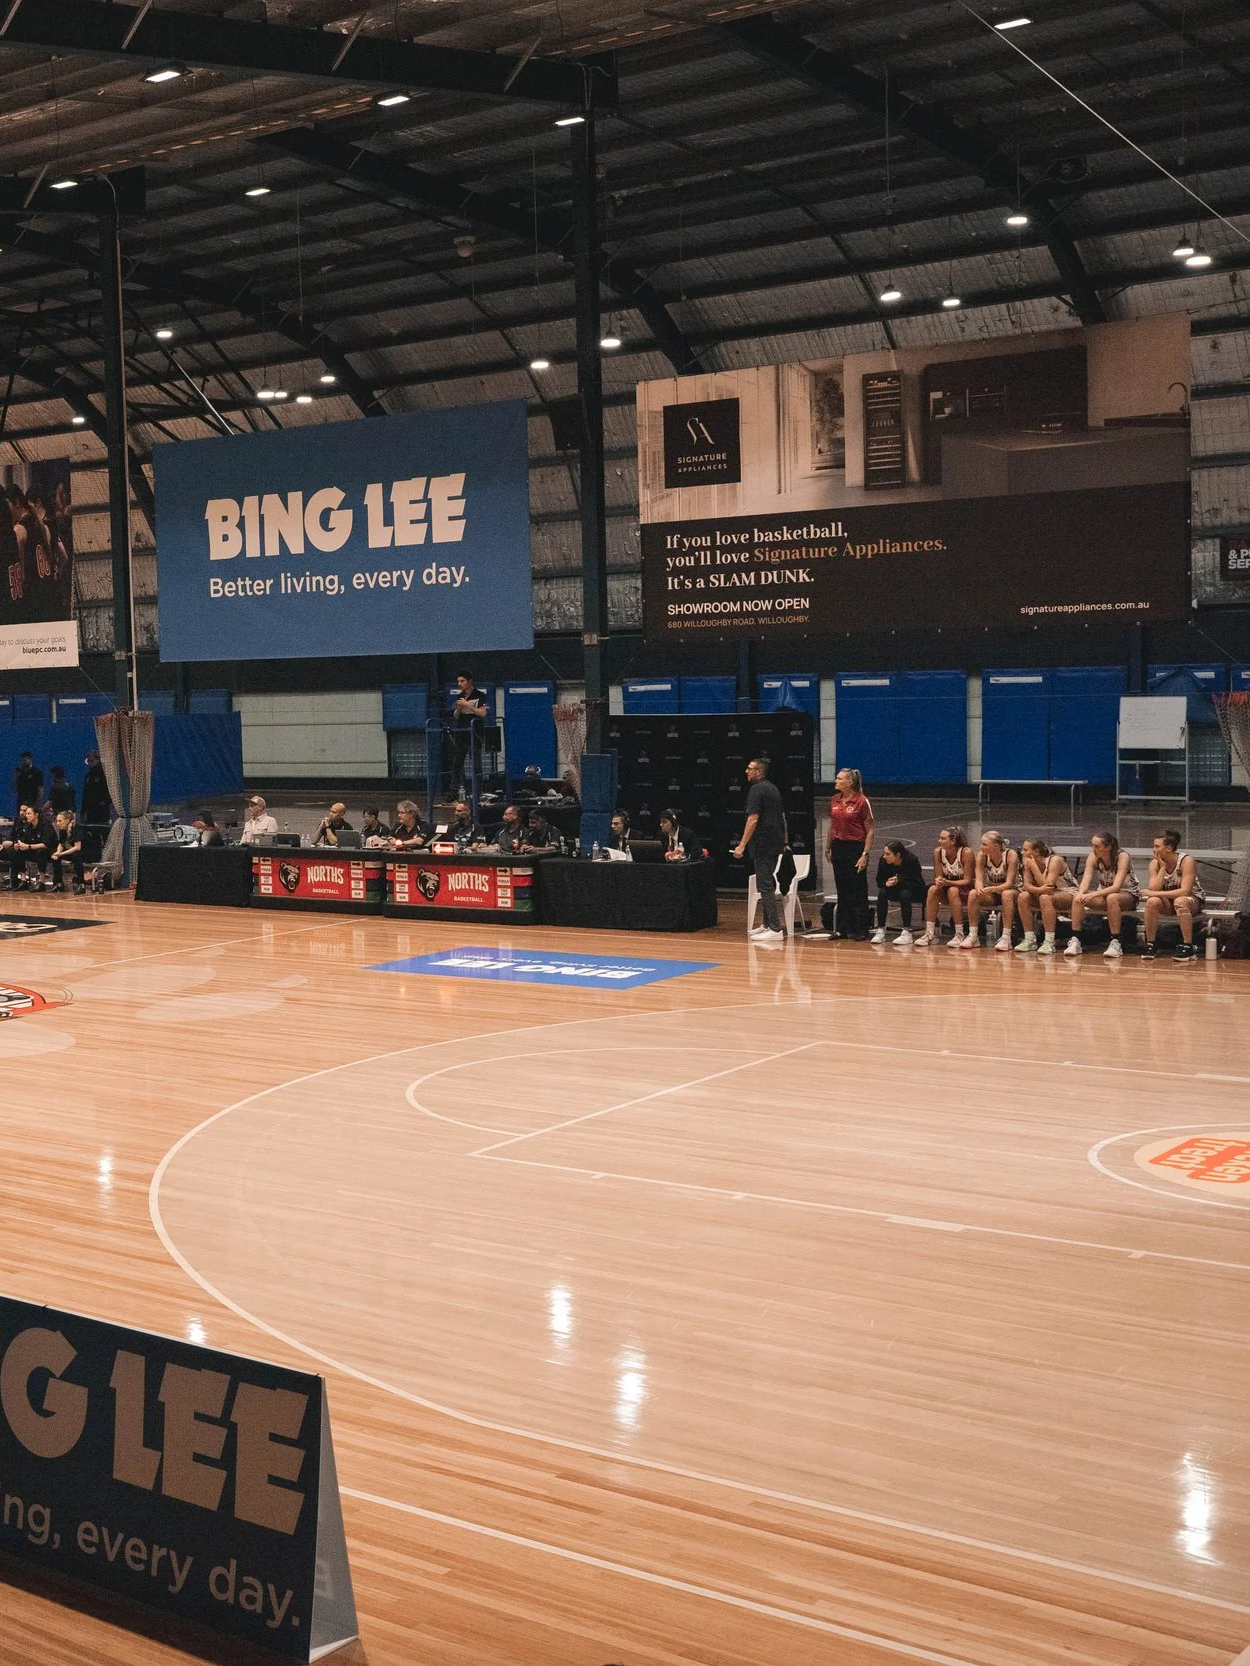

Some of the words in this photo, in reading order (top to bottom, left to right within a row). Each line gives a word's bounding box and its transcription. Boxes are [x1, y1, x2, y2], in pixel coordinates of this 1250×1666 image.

[677, 453, 727, 464] SIGNATURE
[677, 463, 727, 473] APPLIANCES
[204, 486, 353, 560] BING
[364, 472, 466, 549] LEE
[665, 534, 681, 549] If
[682, 536, 711, 552] you
[715, 531, 750, 546] love
[753, 521, 848, 543] basketball,
[665, 550, 712, 572] you’ll
[715, 550, 750, 565] love
[753, 546, 838, 565] Signature
[842, 539, 948, 559] Appliances.
[1228, 549, 1238, 559] &
[1240, 549, 1250, 559] P
[209, 576, 274, 598] Better
[280, 570, 345, 596] living,
[352, 567, 415, 592] every
[422, 561, 470, 589] day.
[666, 574, 692, 590] It’s
[695, 578, 705, 589] a
[709, 571, 756, 588] SLAM
[759, 568, 815, 585] DUNK.
[667, 601, 741, 616] SHOWROOM
[742, 599, 773, 612] NOW
[774, 597, 810, 611] OPEN
[1020, 601, 1150, 616] signatureappliances.com.au
[667, 620, 683, 629] 680
[683, 618, 732, 628] WILLOUGHBY
[14, 637, 36, 646] discuss
[21, 646, 67, 655] bluepc.com.au
[306, 865, 345, 884] NORTHS
[447, 872, 490, 892] NORTHS
[453, 895, 484, 903] BASKETBALL
[109, 1348, 310, 1536] LEE
[76, 1518, 193, 1594] every
[208, 1559, 301, 1630] day.
